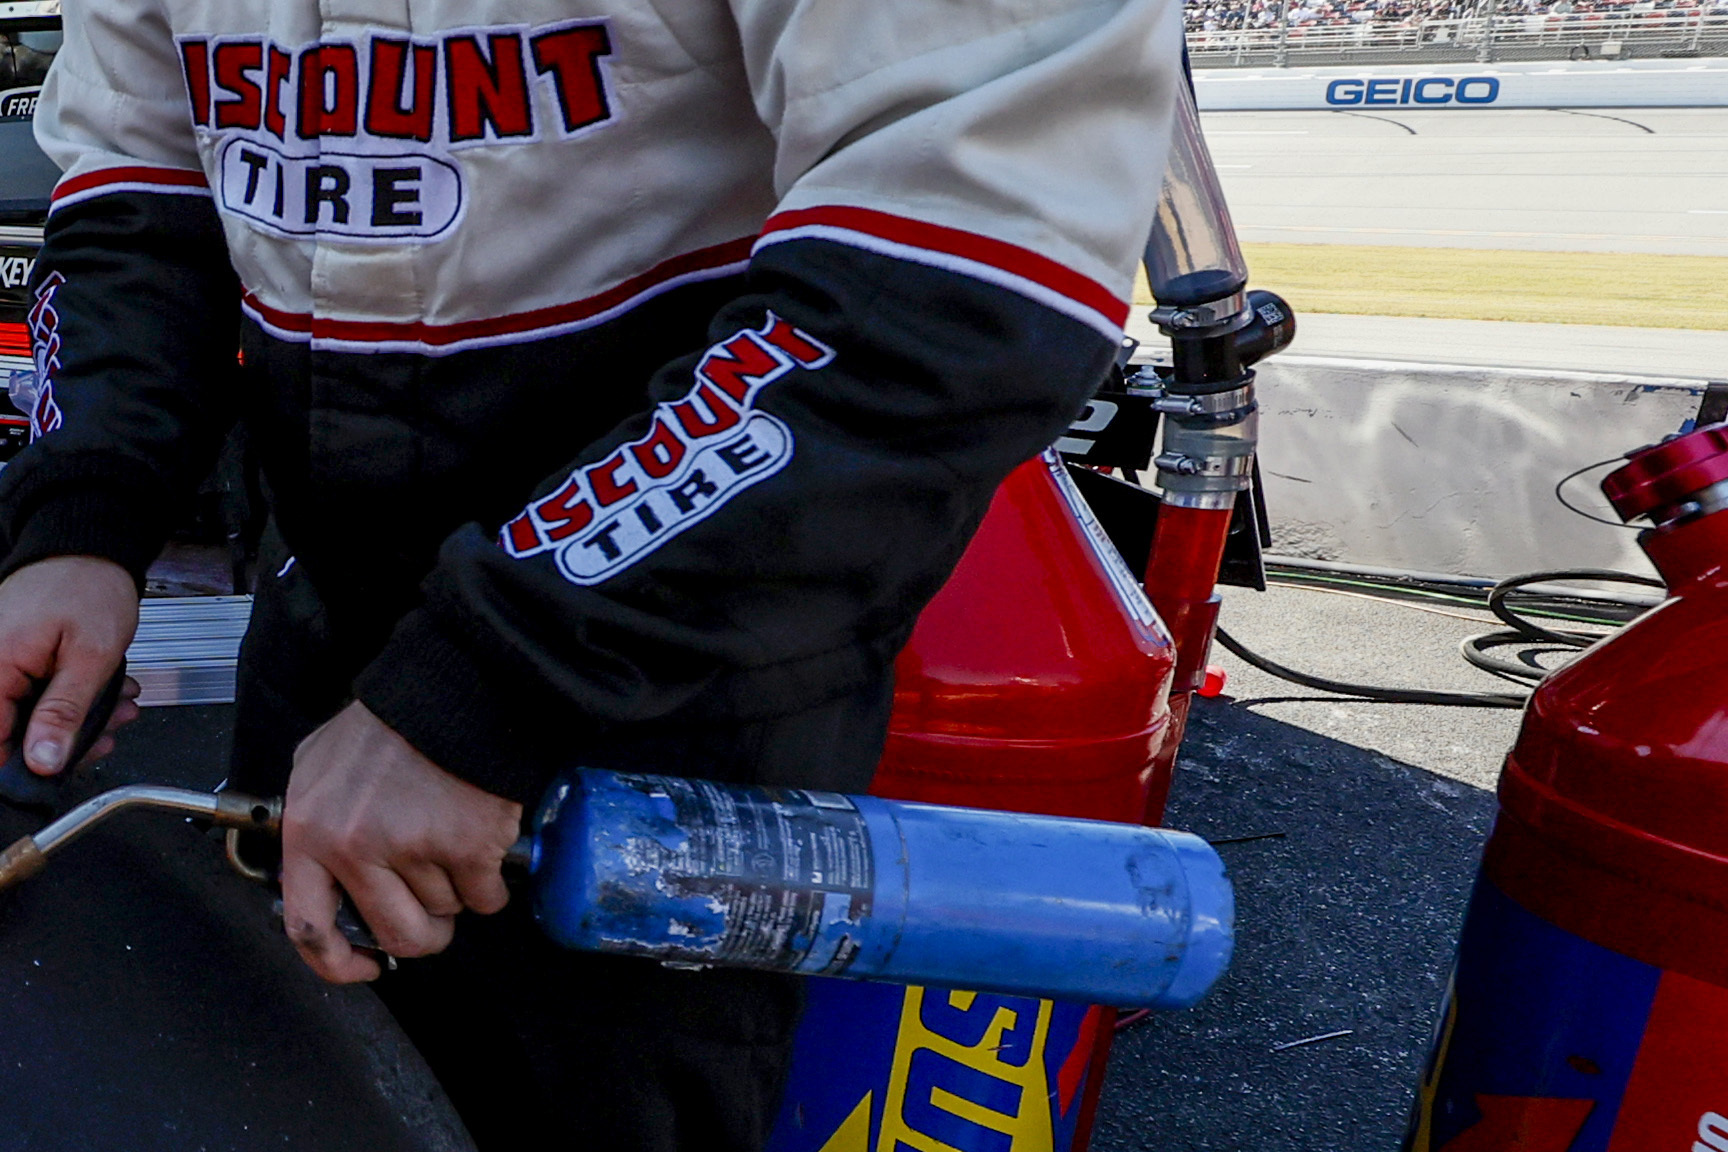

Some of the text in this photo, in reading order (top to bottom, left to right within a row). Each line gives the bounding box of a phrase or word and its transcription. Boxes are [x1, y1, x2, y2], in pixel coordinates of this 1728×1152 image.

[179, 22, 613, 145] ISCOUNT
[1325, 77, 1501, 105] GEICO
[239, 149, 424, 227] TIRE
[502, 312, 834, 556] ISCOUNT
[593, 433, 773, 562] TIRE
